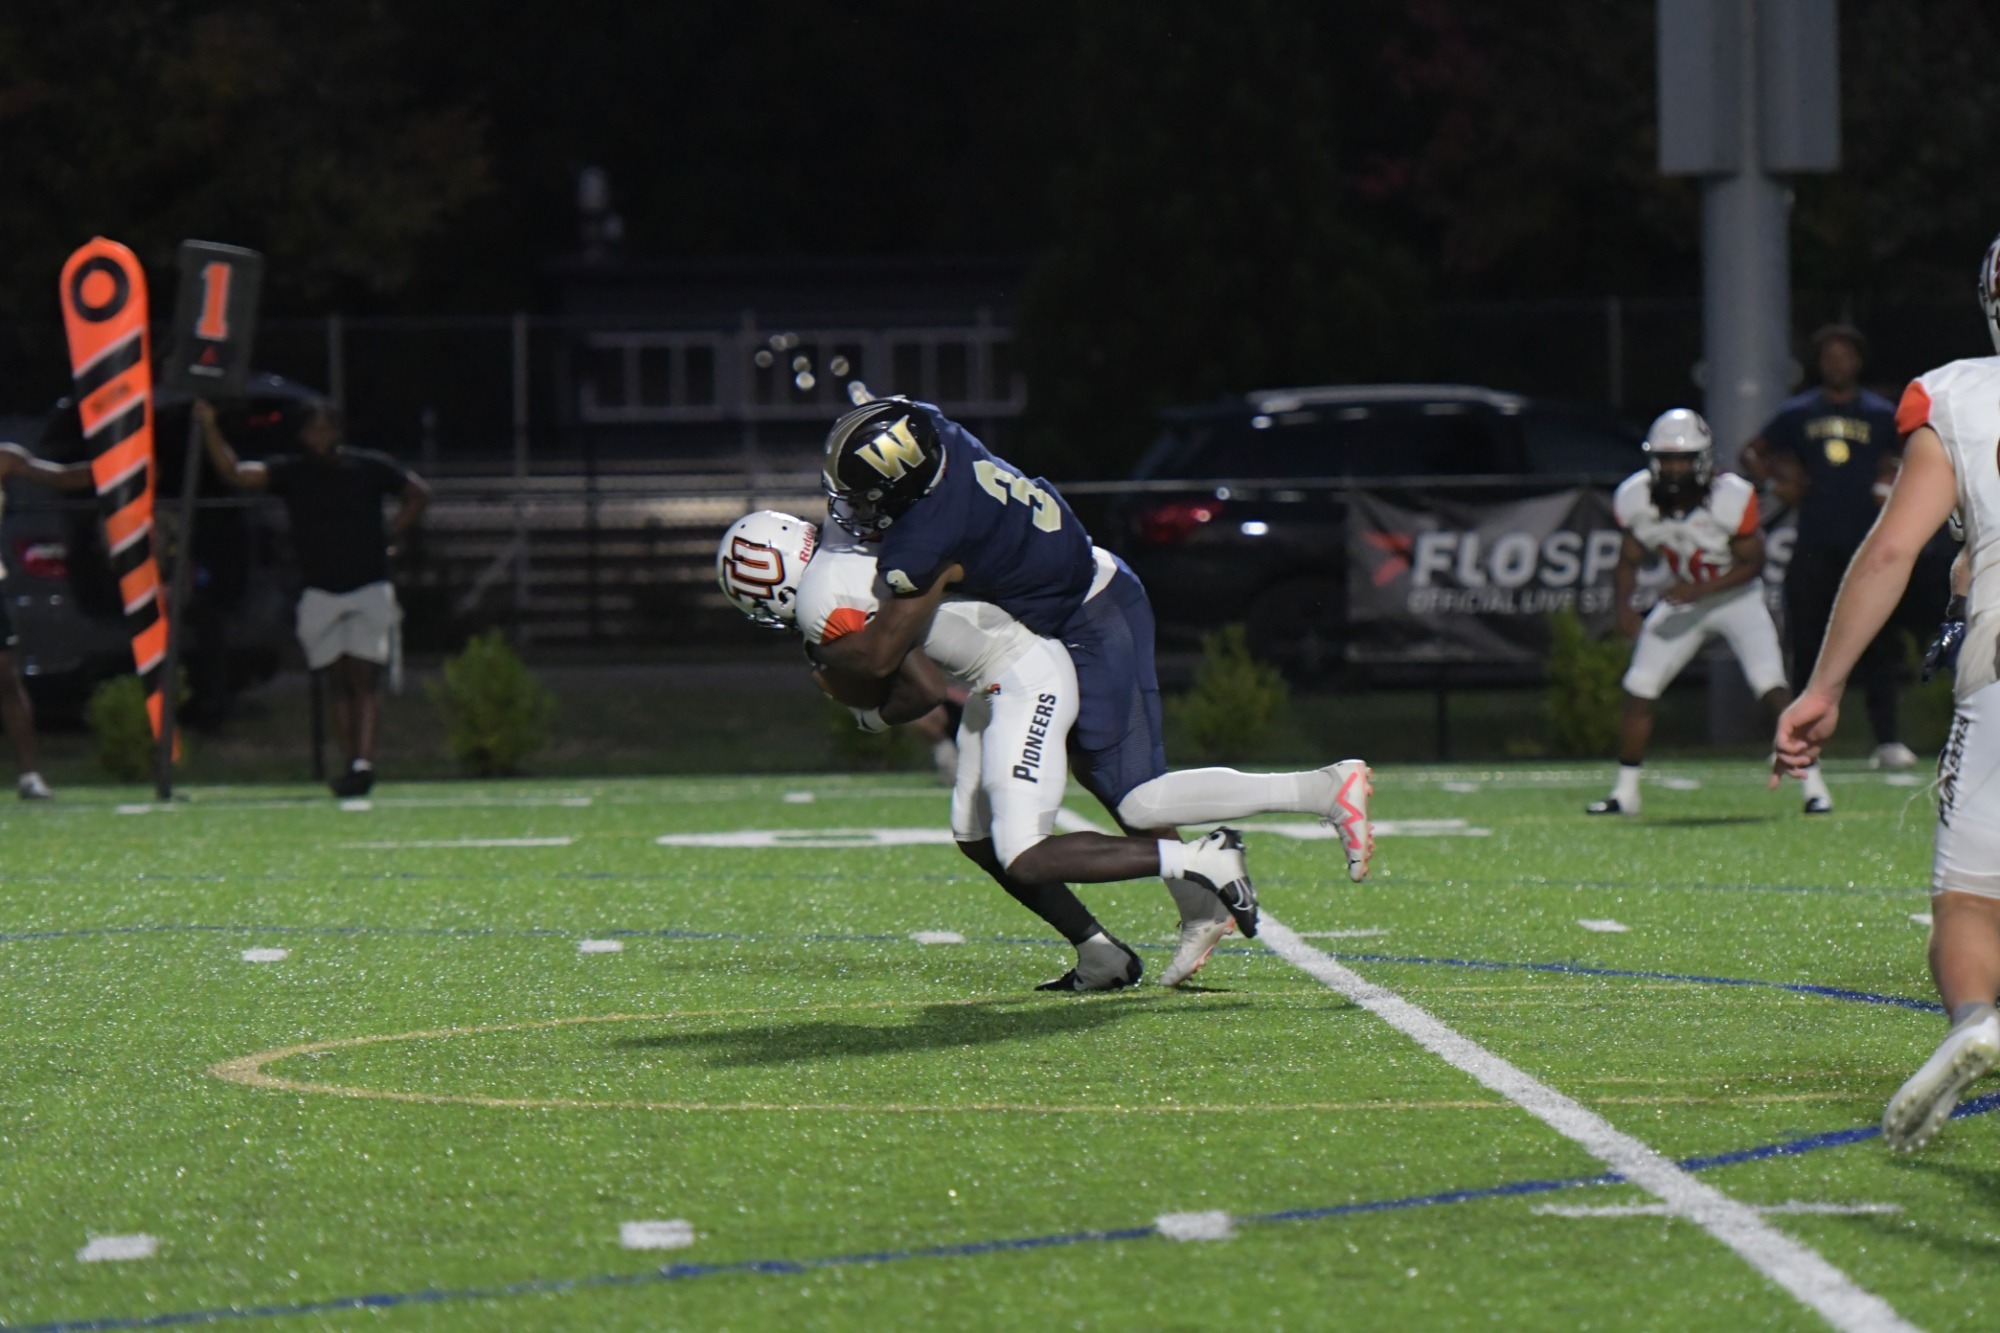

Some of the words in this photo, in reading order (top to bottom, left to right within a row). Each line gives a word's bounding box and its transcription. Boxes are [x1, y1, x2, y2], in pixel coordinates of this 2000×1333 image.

[196, 262, 230, 339] 1
[855, 415, 926, 482] W
[973, 460, 1061, 532] 3
